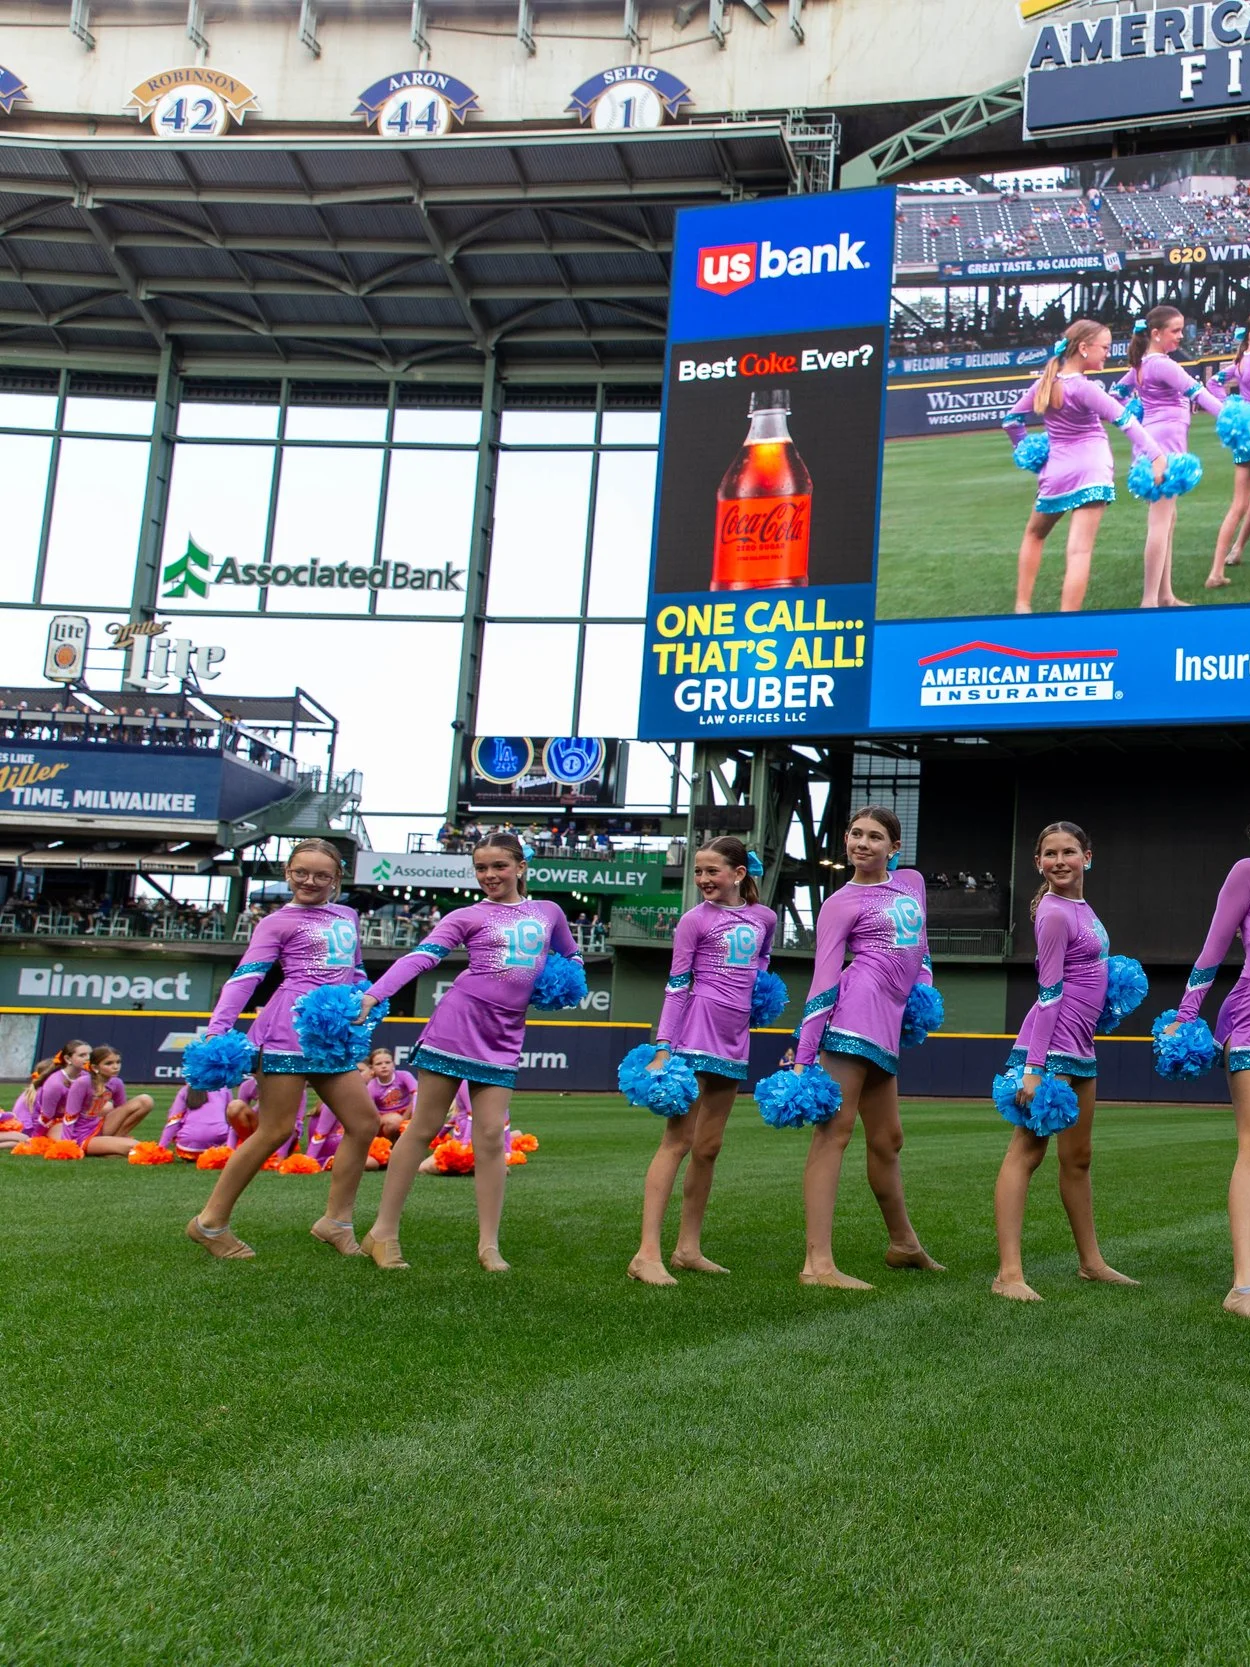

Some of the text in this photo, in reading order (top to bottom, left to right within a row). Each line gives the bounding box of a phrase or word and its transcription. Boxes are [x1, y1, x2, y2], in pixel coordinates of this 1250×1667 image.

[147, 69, 240, 93] ROBINSON
[389, 72, 449, 90] AARON
[604, 67, 658, 84] SELIG
[161, 98, 218, 133] 42
[386, 100, 441, 136] 44
[619, 97, 637, 129] 1
[967, 262, 1001, 275] GREAT
[1002, 260, 1035, 273] TASTE.
[1037, 260, 1050, 270] 96
[1052, 256, 1102, 269] CALORIES.
[1169, 246, 1207, 264] 620
[703, 252, 751, 285] us
[678, 356, 737, 382] Best
[739, 352, 797, 377] Coke
[801, 344, 874, 371] Ever?
[903, 356, 950, 372] WELCOME
[965, 351, 1010, 368] DELICIOUS
[928, 411, 997, 425] WISCONSIN'S
[721, 501, 807, 545] Coca-Cola
[656, 599, 864, 638] ONE CALL...
[54, 623, 85, 642] Lite
[105, 619, 172, 650] Miller
[123, 633, 226, 690] Lite
[652, 635, 866, 675] THAT'S ALL!
[921, 662, 1115, 687] AMERICAN FAMILY
[674, 674, 835, 712] GRUBER
[936, 685, 1098, 701] INSURANCE
[699, 712, 807, 725] LAW OFFICES LLC
[10, 753, 35, 764] LIKE
[11, 787, 196, 812] TIME, MILWAUKEE
[527, 868, 648, 886] POWER ALLEY
[53, 963, 192, 1005] impact
